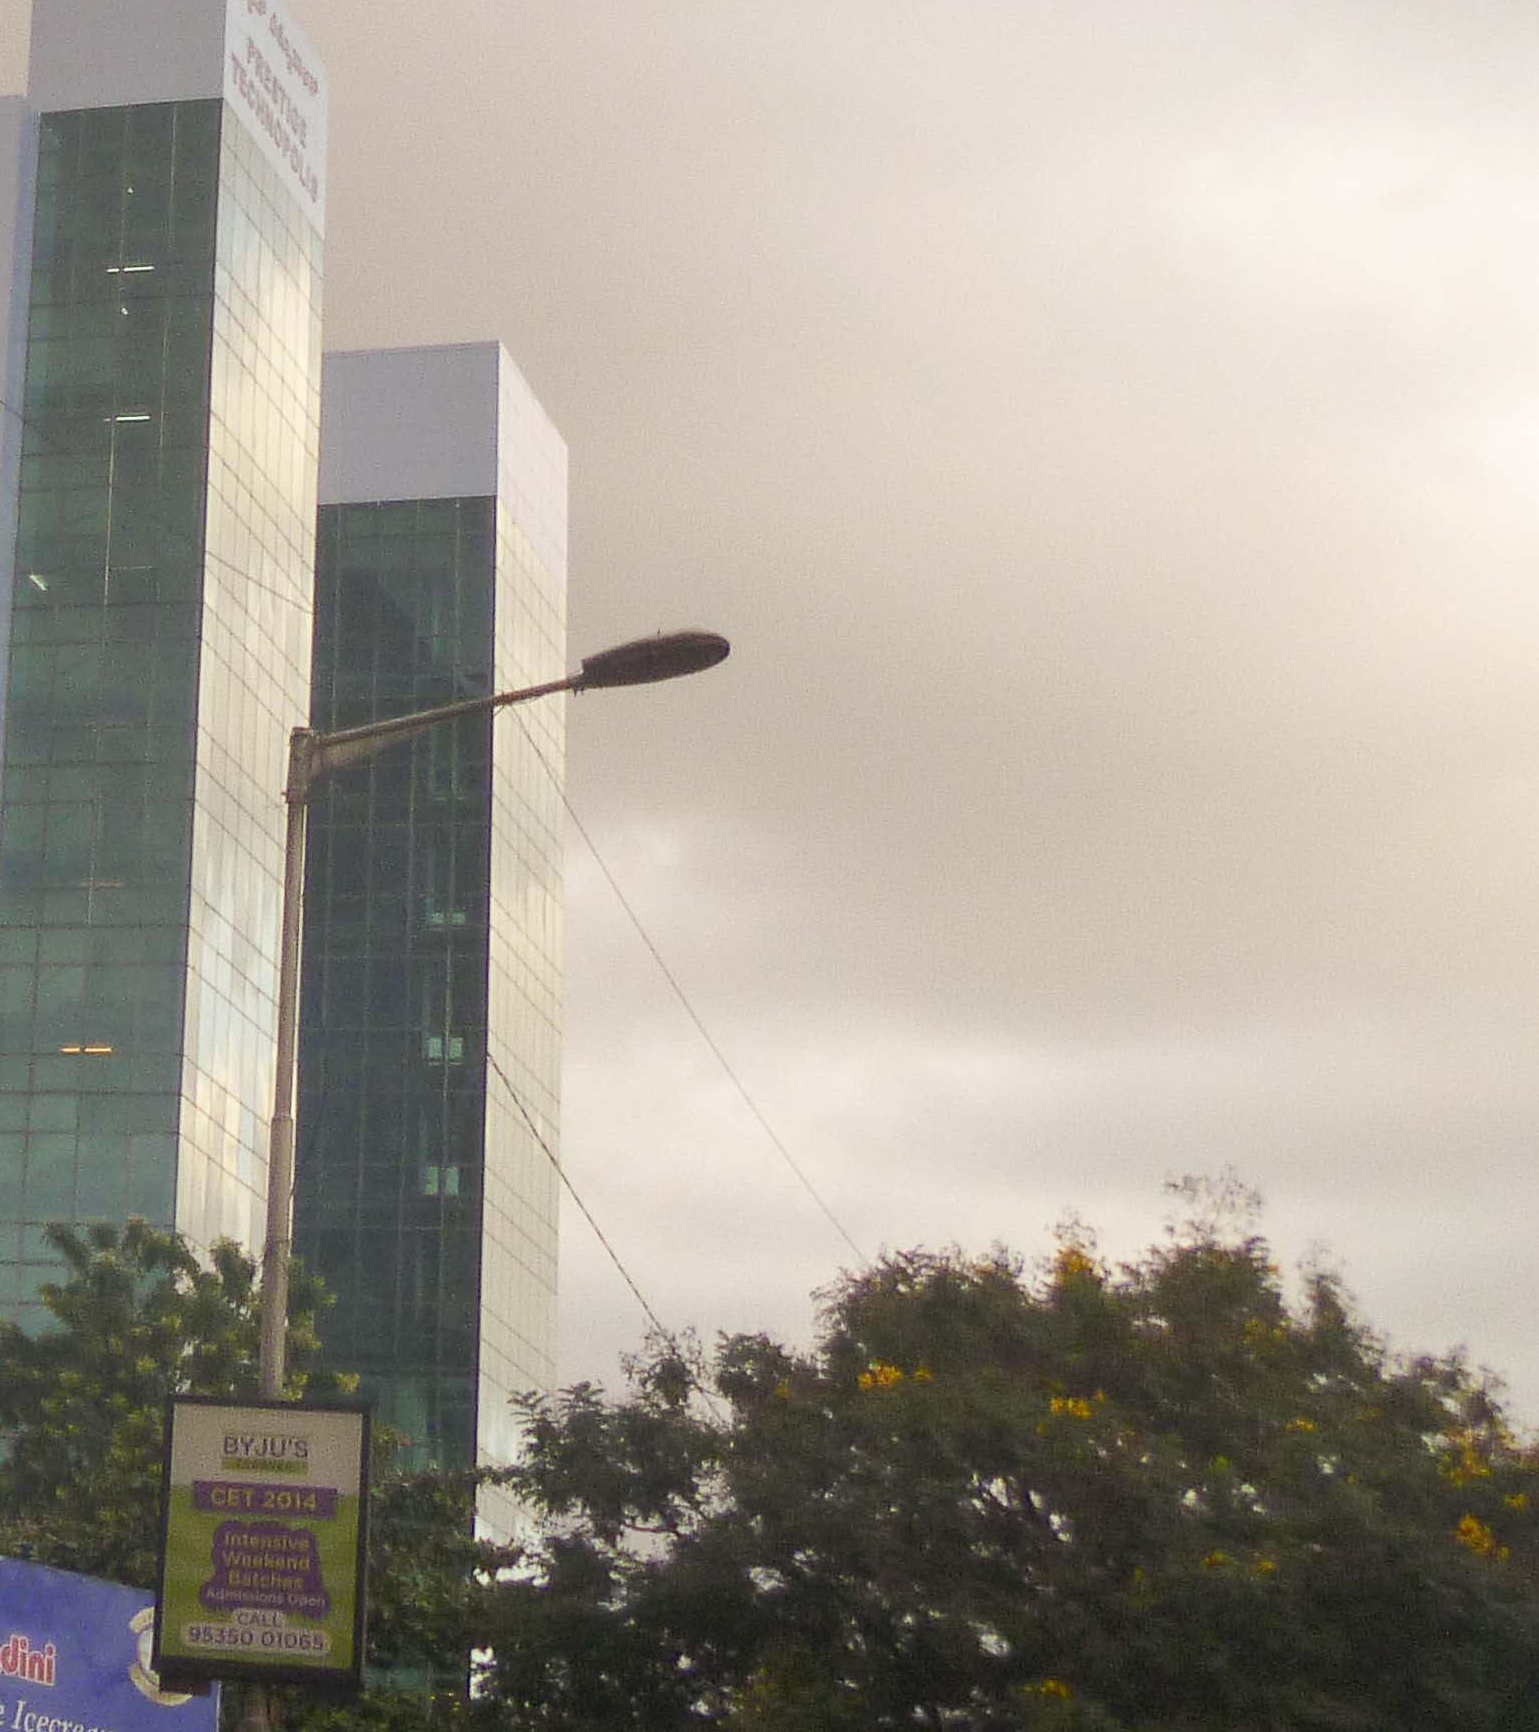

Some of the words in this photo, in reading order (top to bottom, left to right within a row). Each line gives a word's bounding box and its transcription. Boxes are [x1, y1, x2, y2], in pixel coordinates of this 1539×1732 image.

[223, 1435, 309, 1458] BYJU'S
[210, 1487, 255, 1509] CET
[264, 1490, 317, 1511] 2014
[224, 1531, 310, 1551] Intensive
[188, 1626, 254, 1645] 95350
